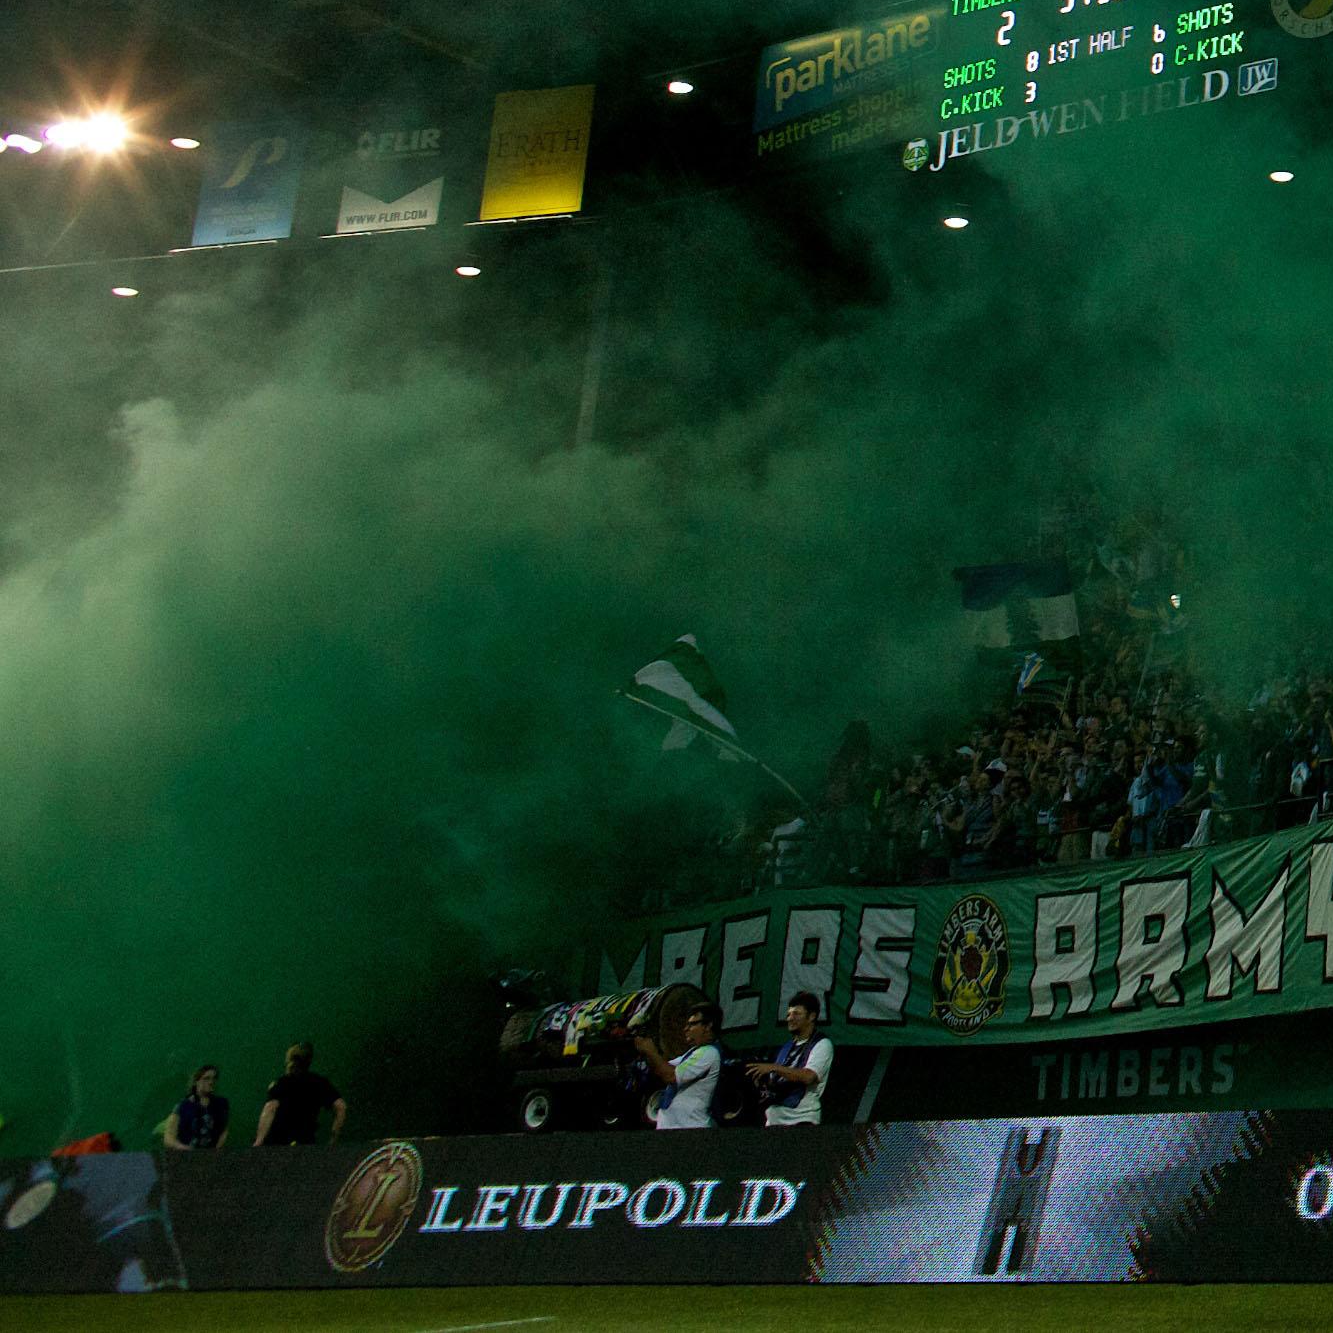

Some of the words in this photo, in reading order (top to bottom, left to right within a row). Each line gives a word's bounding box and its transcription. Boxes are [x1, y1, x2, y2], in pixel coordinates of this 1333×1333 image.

[997, 10, 1016, 47] 2
[1176, 2, 1235, 35] SHOTS
[1025, 49, 1041, 74] 8
[1047, 38, 1081, 66] 1ST
[1089, 25, 1135, 56] HALF
[774, 14, 931, 113] parklane
[944, 58, 997, 90] SHOTS
[1242, 62, 1274, 93] JW
[1025, 81, 1038, 104] 3
[1115, 69, 1230, 122] FIELD
[378, 128, 442, 153] FLIR
[496, 128, 582, 159] ERATH
[757, 108, 843, 157] Mattress
[345, 209, 428, 226] WWW.FLIR.COM
[1031, 1044, 1235, 1101] TIMBERS
[417, 1176, 803, 1234] LEUPOLD
